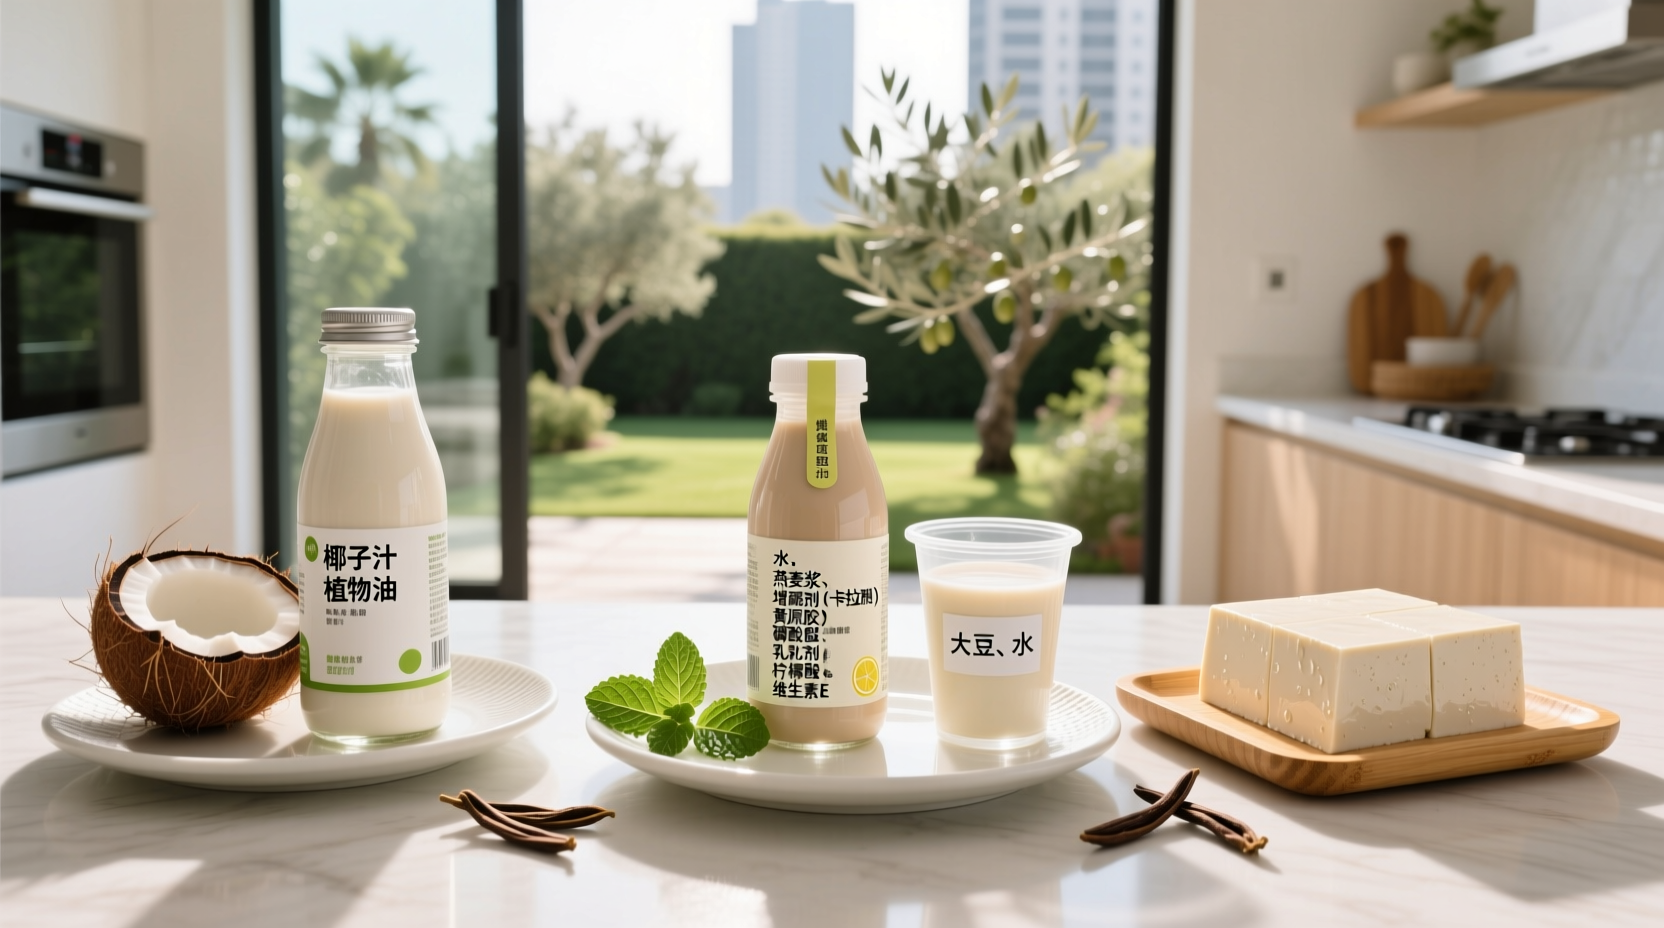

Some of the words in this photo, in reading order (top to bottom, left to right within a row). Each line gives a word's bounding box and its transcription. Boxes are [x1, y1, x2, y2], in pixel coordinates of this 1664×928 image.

[323, 543, 397, 571] 椰子汁
[323, 575, 397, 603] 植物油
[950, 631, 1034, 657] 大豆、水
[772, 679, 830, 700] 维生素E
